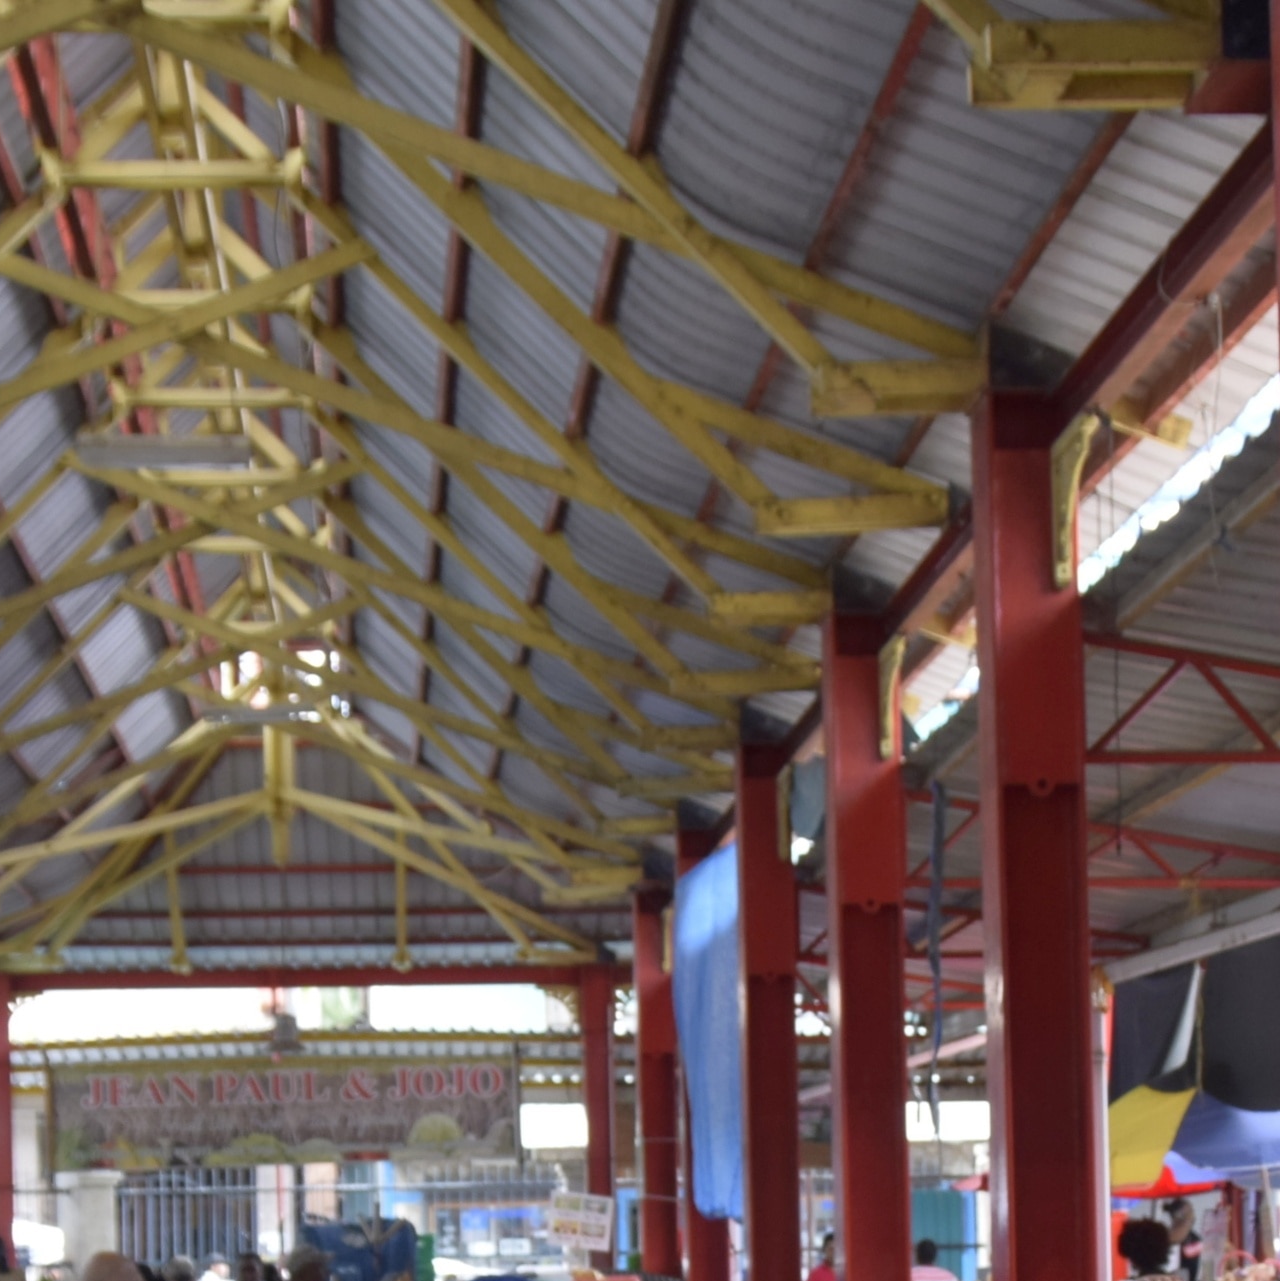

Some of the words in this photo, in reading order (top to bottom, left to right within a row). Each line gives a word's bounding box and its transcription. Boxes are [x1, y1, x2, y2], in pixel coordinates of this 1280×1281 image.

[82, 1071, 198, 1108] JEAN
[211, 1069, 329, 1104] PAUL
[340, 1068, 377, 1102] &
[387, 1063, 505, 1100] JOJO
